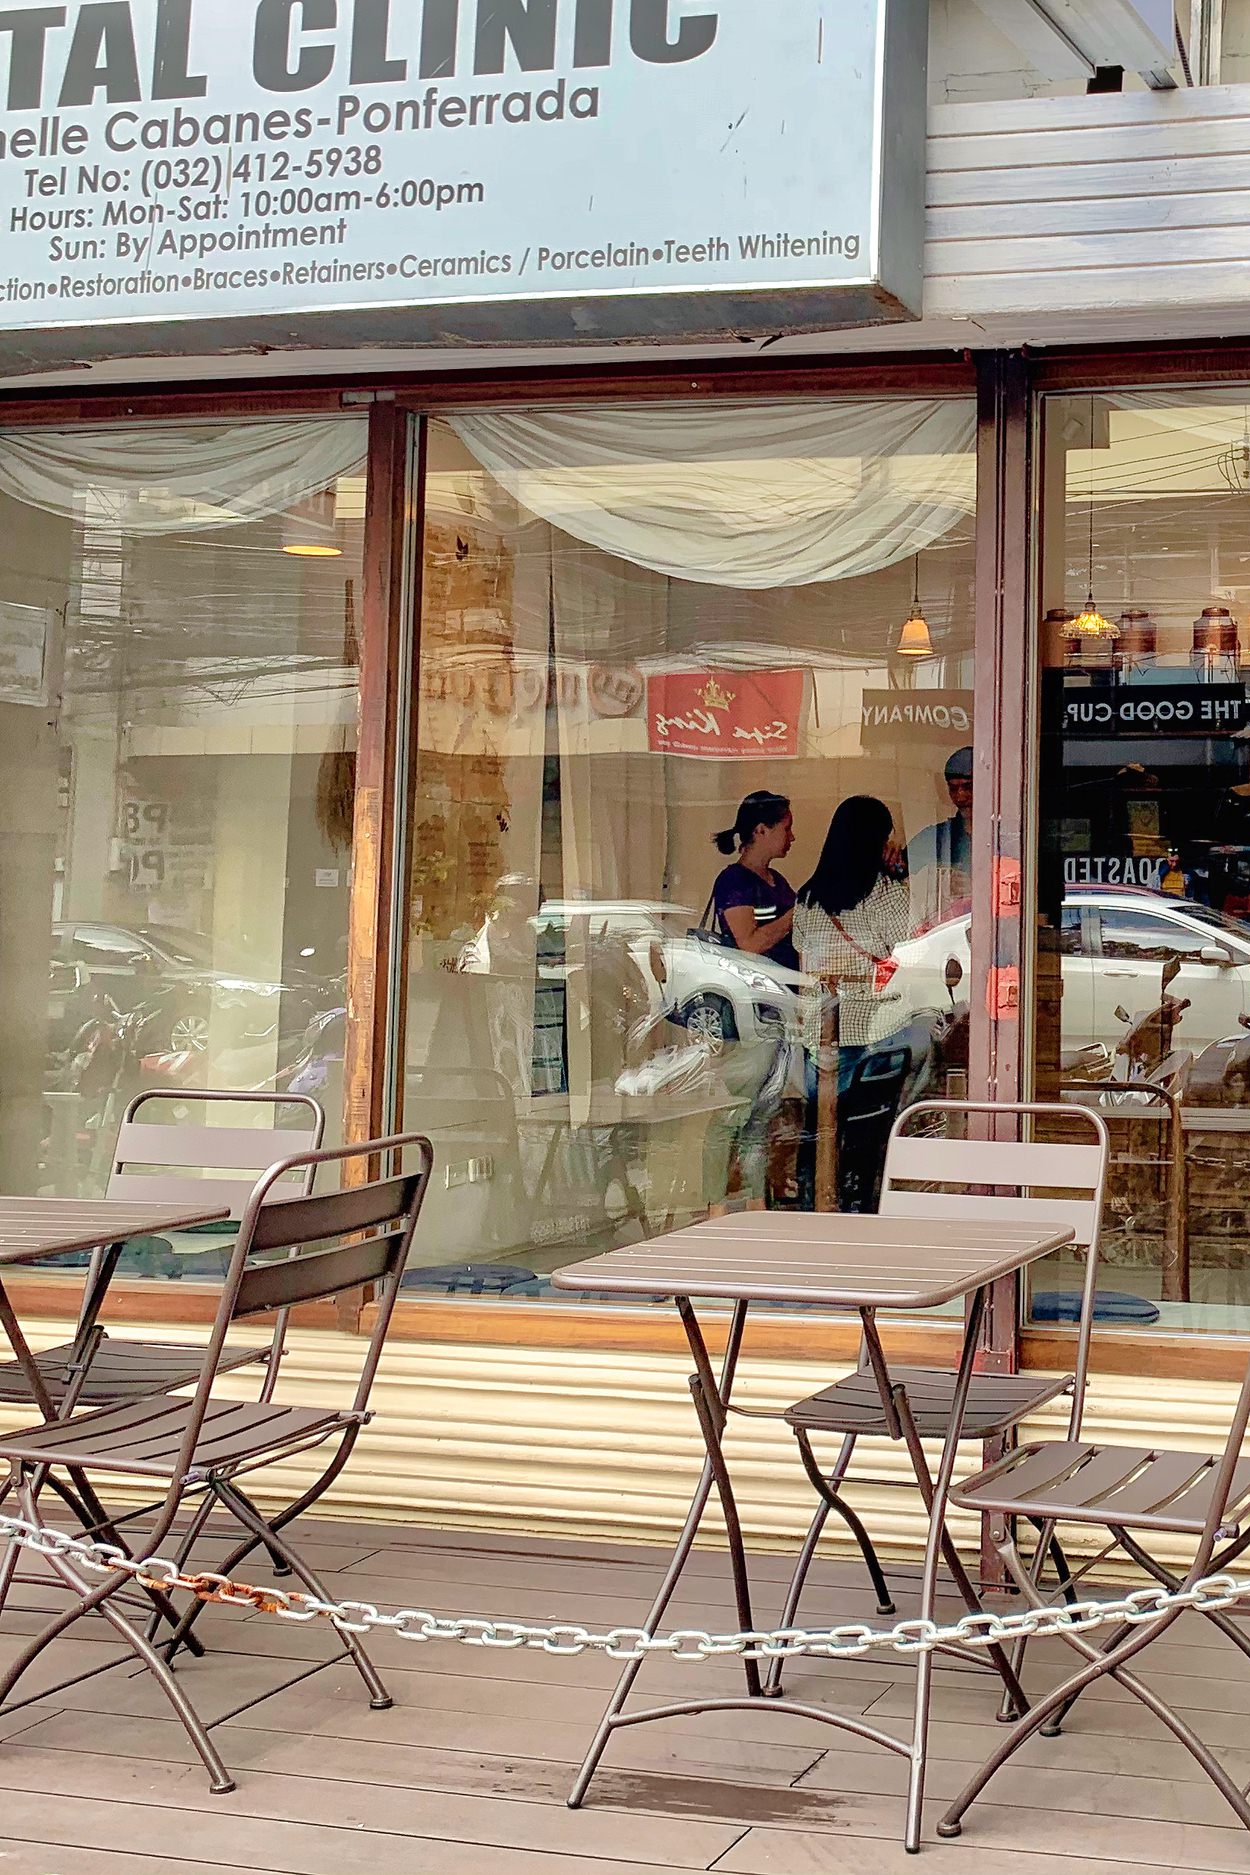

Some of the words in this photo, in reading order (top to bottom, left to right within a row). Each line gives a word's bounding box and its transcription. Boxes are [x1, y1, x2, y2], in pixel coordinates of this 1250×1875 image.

[0, 0, 208, 111] TAL
[253, 0, 719, 93] CLINIC
[0, 115, 89, 160] elle
[105, 78, 599, 152] Cabanes-Ponferrada
[24, 166, 67, 197] Tel
[77, 165, 130, 195] No:
[141, 155, 222, 197] (032)
[233, 145, 382, 184] 412-5938
[10, 206, 93, 232] Hours:
[102, 194, 228, 226] Mon-Sat:
[241, 179, 484, 217] 10:00am-6:00pm
[49, 234, 106, 262] Sun:
[116, 232, 149, 262] By
[157, 218, 347, 260] Appointment
[739, 230, 860, 260] Whitening
